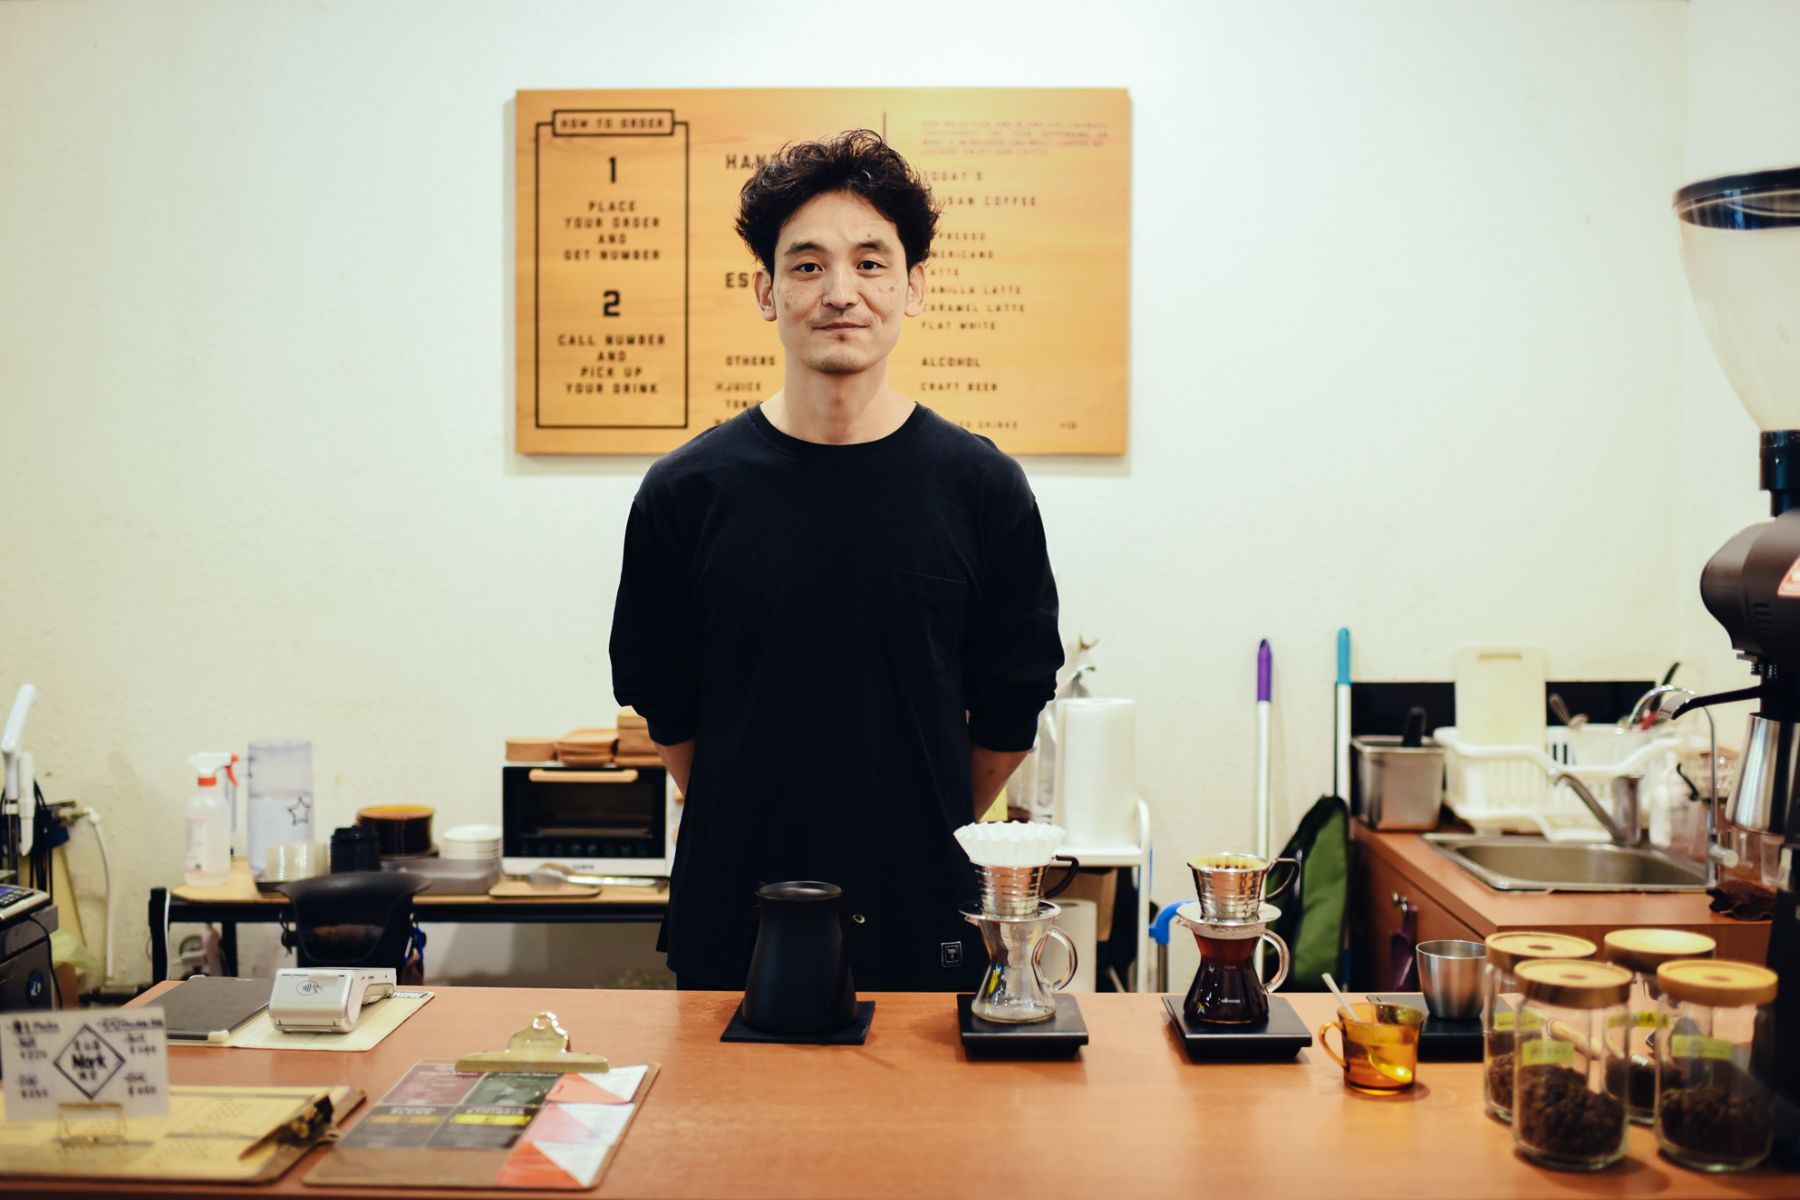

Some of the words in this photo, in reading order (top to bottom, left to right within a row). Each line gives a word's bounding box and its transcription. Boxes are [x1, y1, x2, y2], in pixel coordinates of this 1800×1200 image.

[560, 117, 589, 129] HOW
[597, 117, 613, 129] TO
[621, 117, 664, 129] ORDER
[608, 156, 617, 184] 1
[588, 200, 635, 212] PLACE
[985, 195, 1036, 206] COFFEE
[565, 217, 603, 229] YOUR
[613, 217, 660, 229] ORDER
[597, 234, 627, 246] AND
[938, 232, 986, 242] PRESSO
[564, 249, 590, 262] GET
[600, 250, 660, 262] NUMBER
[930, 249, 994, 260] MERICANO
[930, 267, 960, 277] ATTE
[930, 285, 977, 295] ANILLA
[983, 285, 1022, 295] LATTE
[603, 289, 621, 317] 2
[987, 302, 1025, 313] LATTE
[921, 319, 952, 330] FLAT
[960, 320, 996, 331] WHITE
[557, 334, 596, 346] CALL
[605, 334, 665, 346] NUMBER
[597, 351, 627, 362] AND
[726, 355, 776, 367] OTHERS
[921, 357, 980, 368] ALCOHOL
[581, 367, 615, 379] PICK
[623, 367, 643, 379] UP
[566, 383, 604, 395] YOUR
[613, 383, 658, 395] DRINK
[921, 381, 960, 392] CRAFT
[967, 381, 998, 392] BEER
